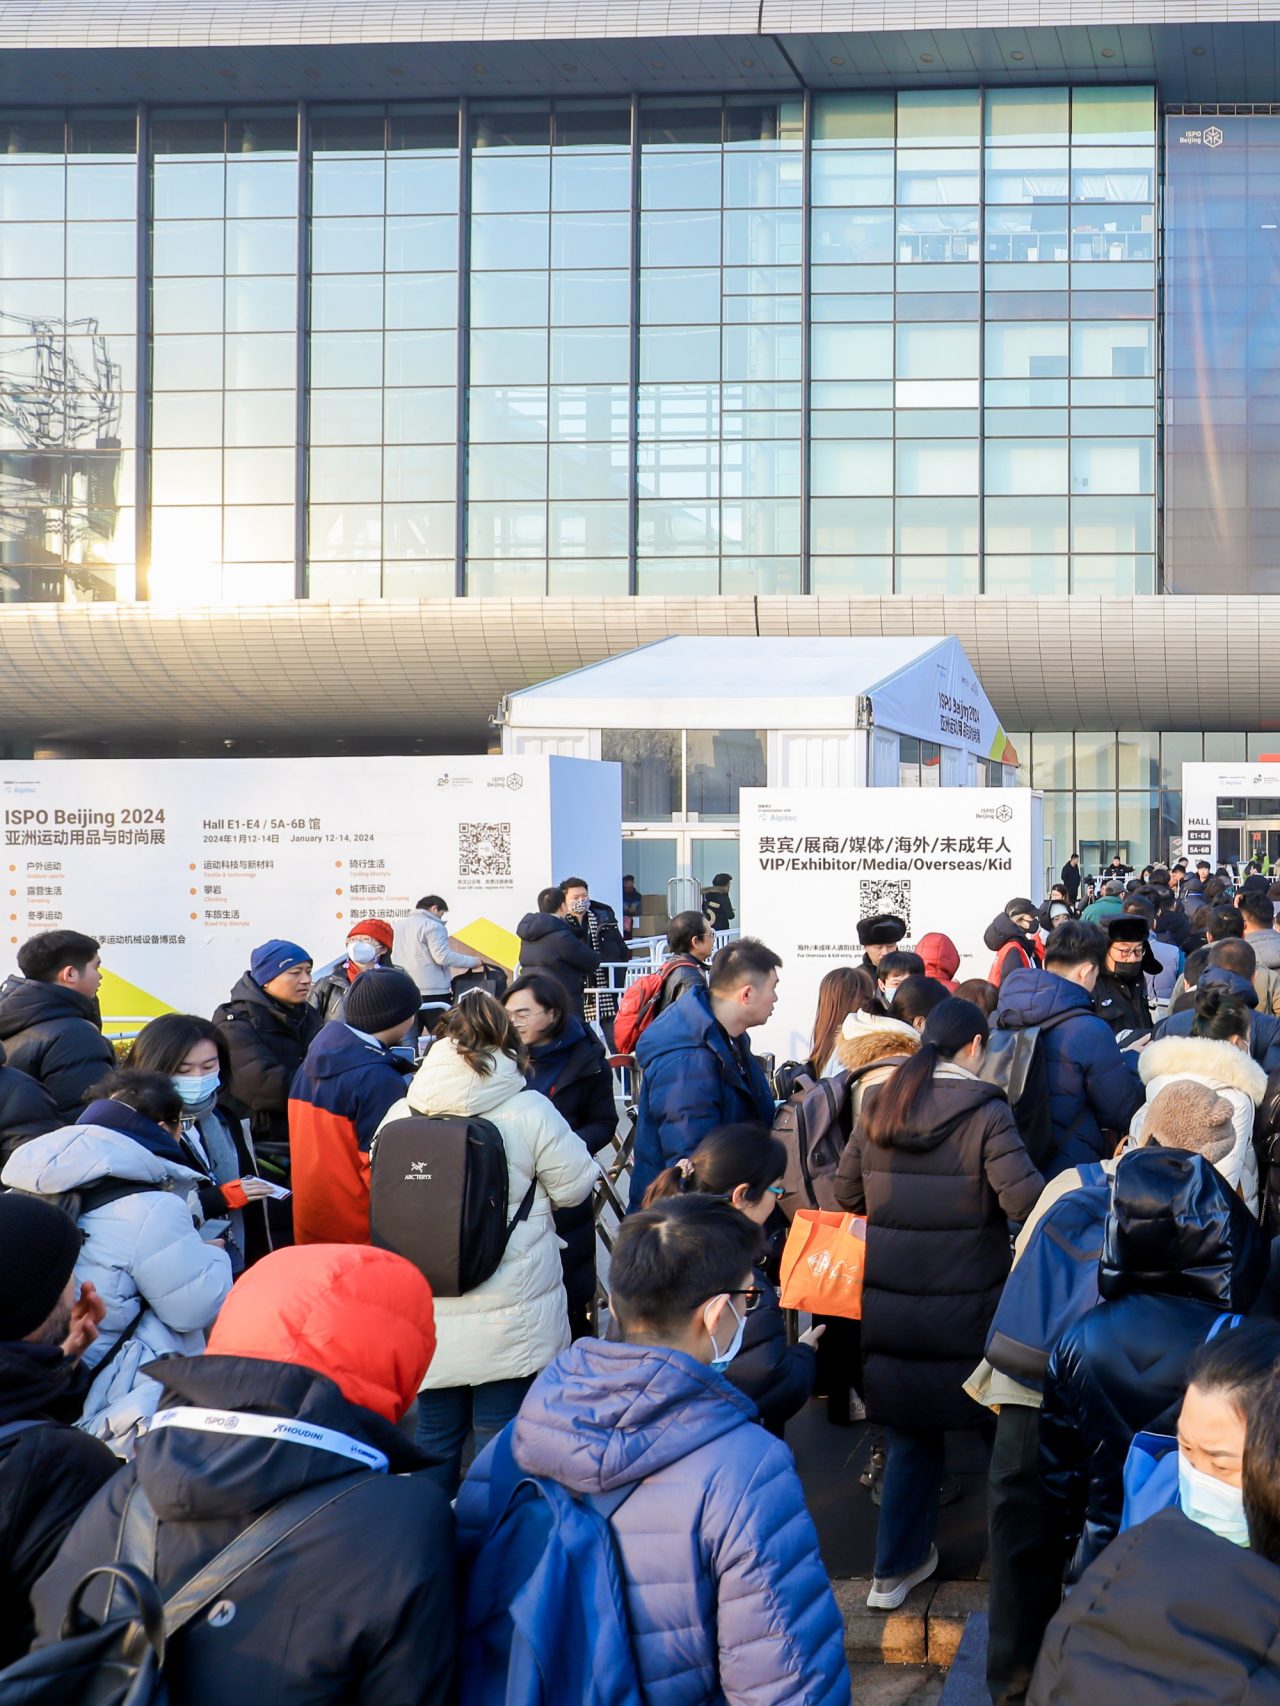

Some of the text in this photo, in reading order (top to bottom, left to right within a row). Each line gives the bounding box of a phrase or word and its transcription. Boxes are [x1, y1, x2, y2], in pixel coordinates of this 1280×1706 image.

[5, 808, 165, 828] ISPO Beijing 2024
[1188, 818, 1210, 826] HALL
[203, 820, 224, 829] Hall
[227, 820, 260, 829] E1-E4
[271, 819, 306, 829] 5A-6B
[308, 818, 321, 830] 馆
[5, 829, 166, 845] 亚洲运动用品与时尚展
[203, 834, 374, 843] 2024年1月12-14日 January 12-14, 2024
[1190, 832, 1209, 840] E1-E4
[758, 836, 1012, 853] 贵宾/展商/媒体/海外/未成年人
[26, 862, 62, 871] 户外运动
[203, 860, 274, 870] 运动科技与新材料
[350, 859, 385, 869] 骑行生活
[759, 858, 1012, 871] VIP/Exhibitor/Media/Overseas/Kid
[26, 886, 63, 896] 露营生活
[203, 885, 222, 895] 攀岩
[350, 884, 386, 894] 城市运动
[27, 910, 63, 920] 冬季运动
[204, 910, 240, 919] 车旅生活
[284, 1426, 323, 1441] HOUDINI
